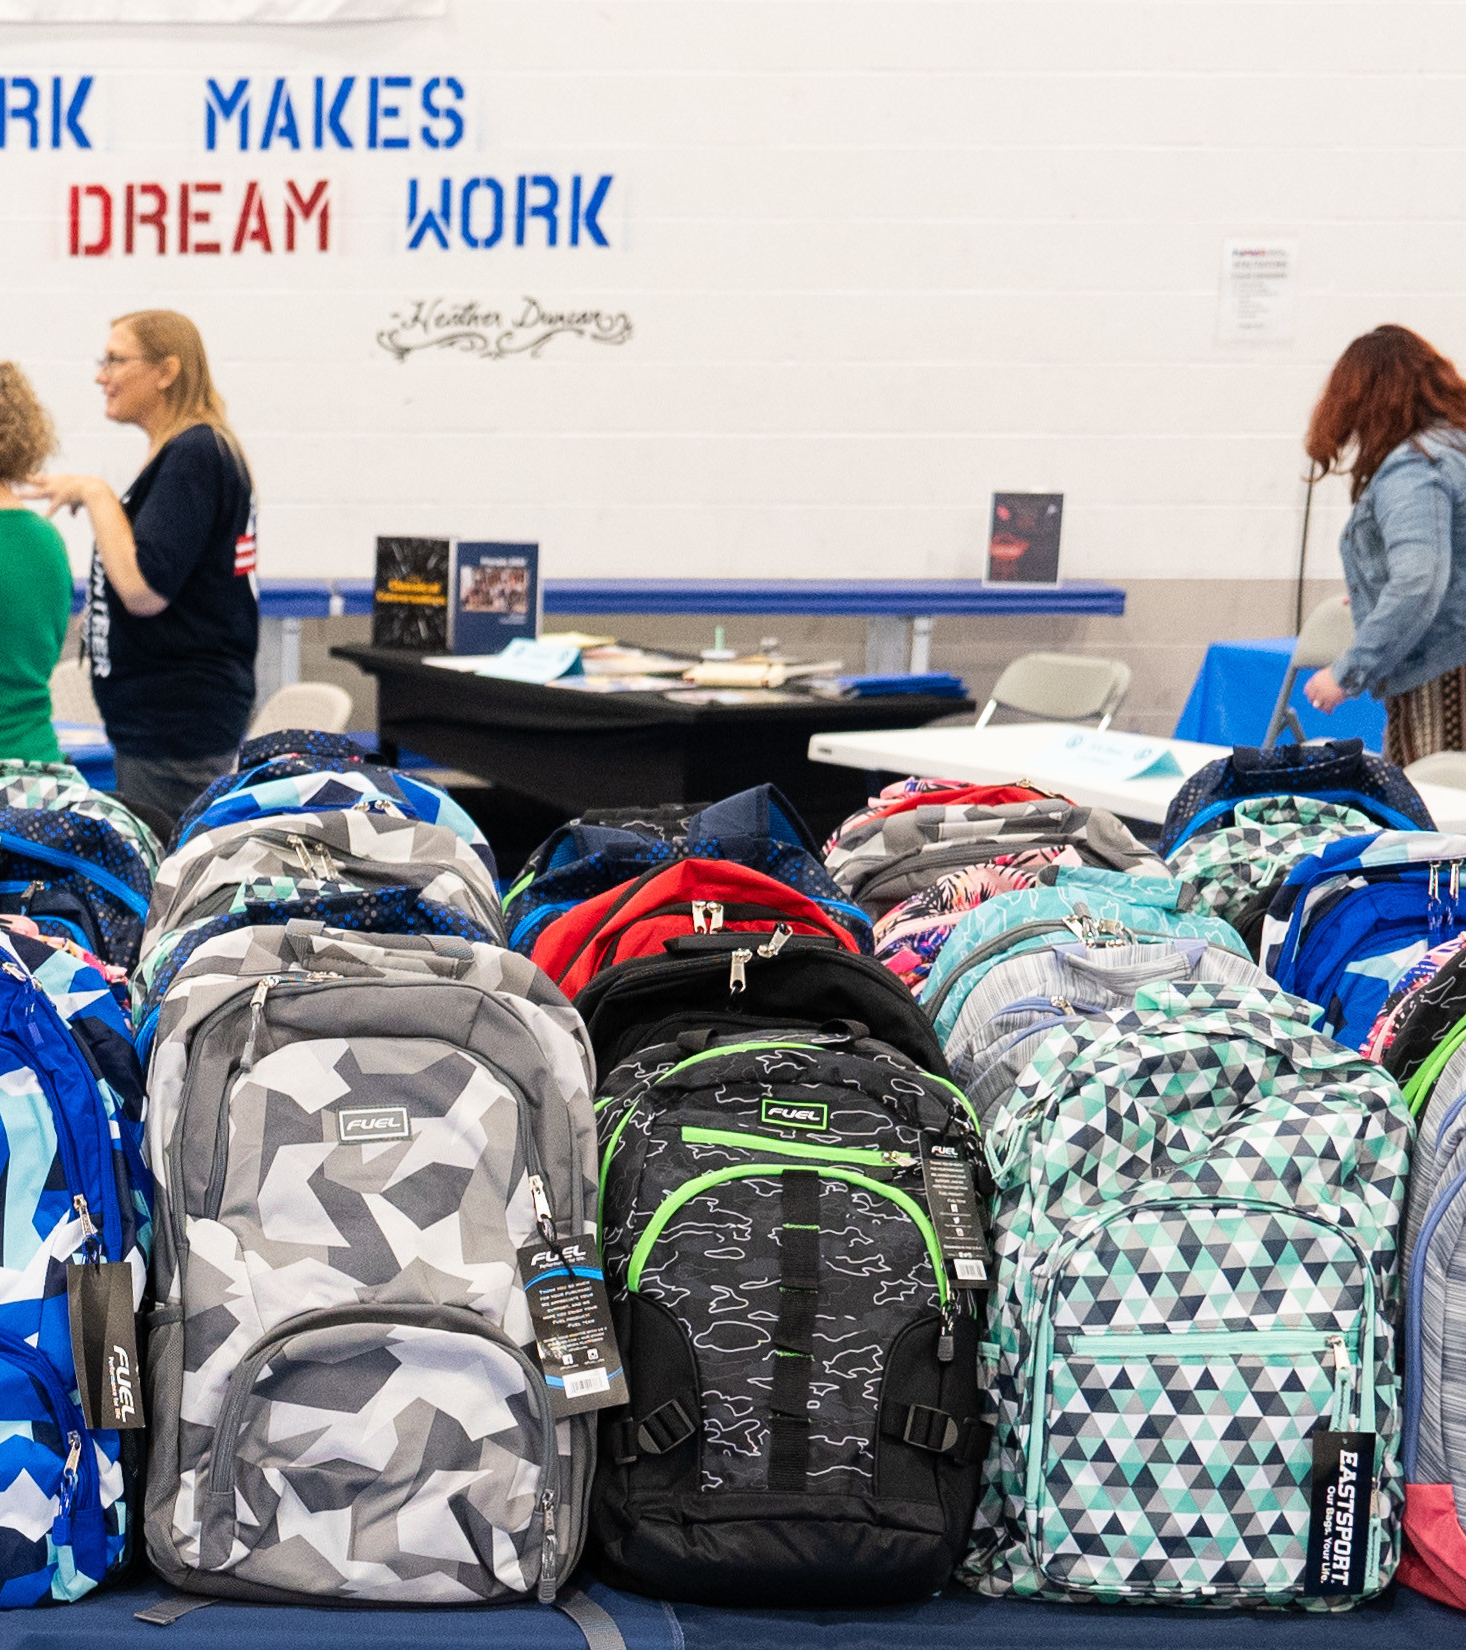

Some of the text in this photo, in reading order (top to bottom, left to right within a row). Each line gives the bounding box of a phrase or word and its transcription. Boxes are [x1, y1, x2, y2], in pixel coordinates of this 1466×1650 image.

[204, 75, 468, 152] MAKES
[68, 180, 332, 258] DREAM
[405, 174, 613, 252] WORK
[345, 1115, 400, 1131] FUEL
[766, 1107, 820, 1121] FUEL
[931, 1145, 958, 1156] FUEL
[113, 1345, 135, 1423] FUEL
[1326, 1486, 1336, 1506] Our
[1331, 1449, 1358, 1586] EASTSPORT
[1322, 1537, 1333, 1561] Your
